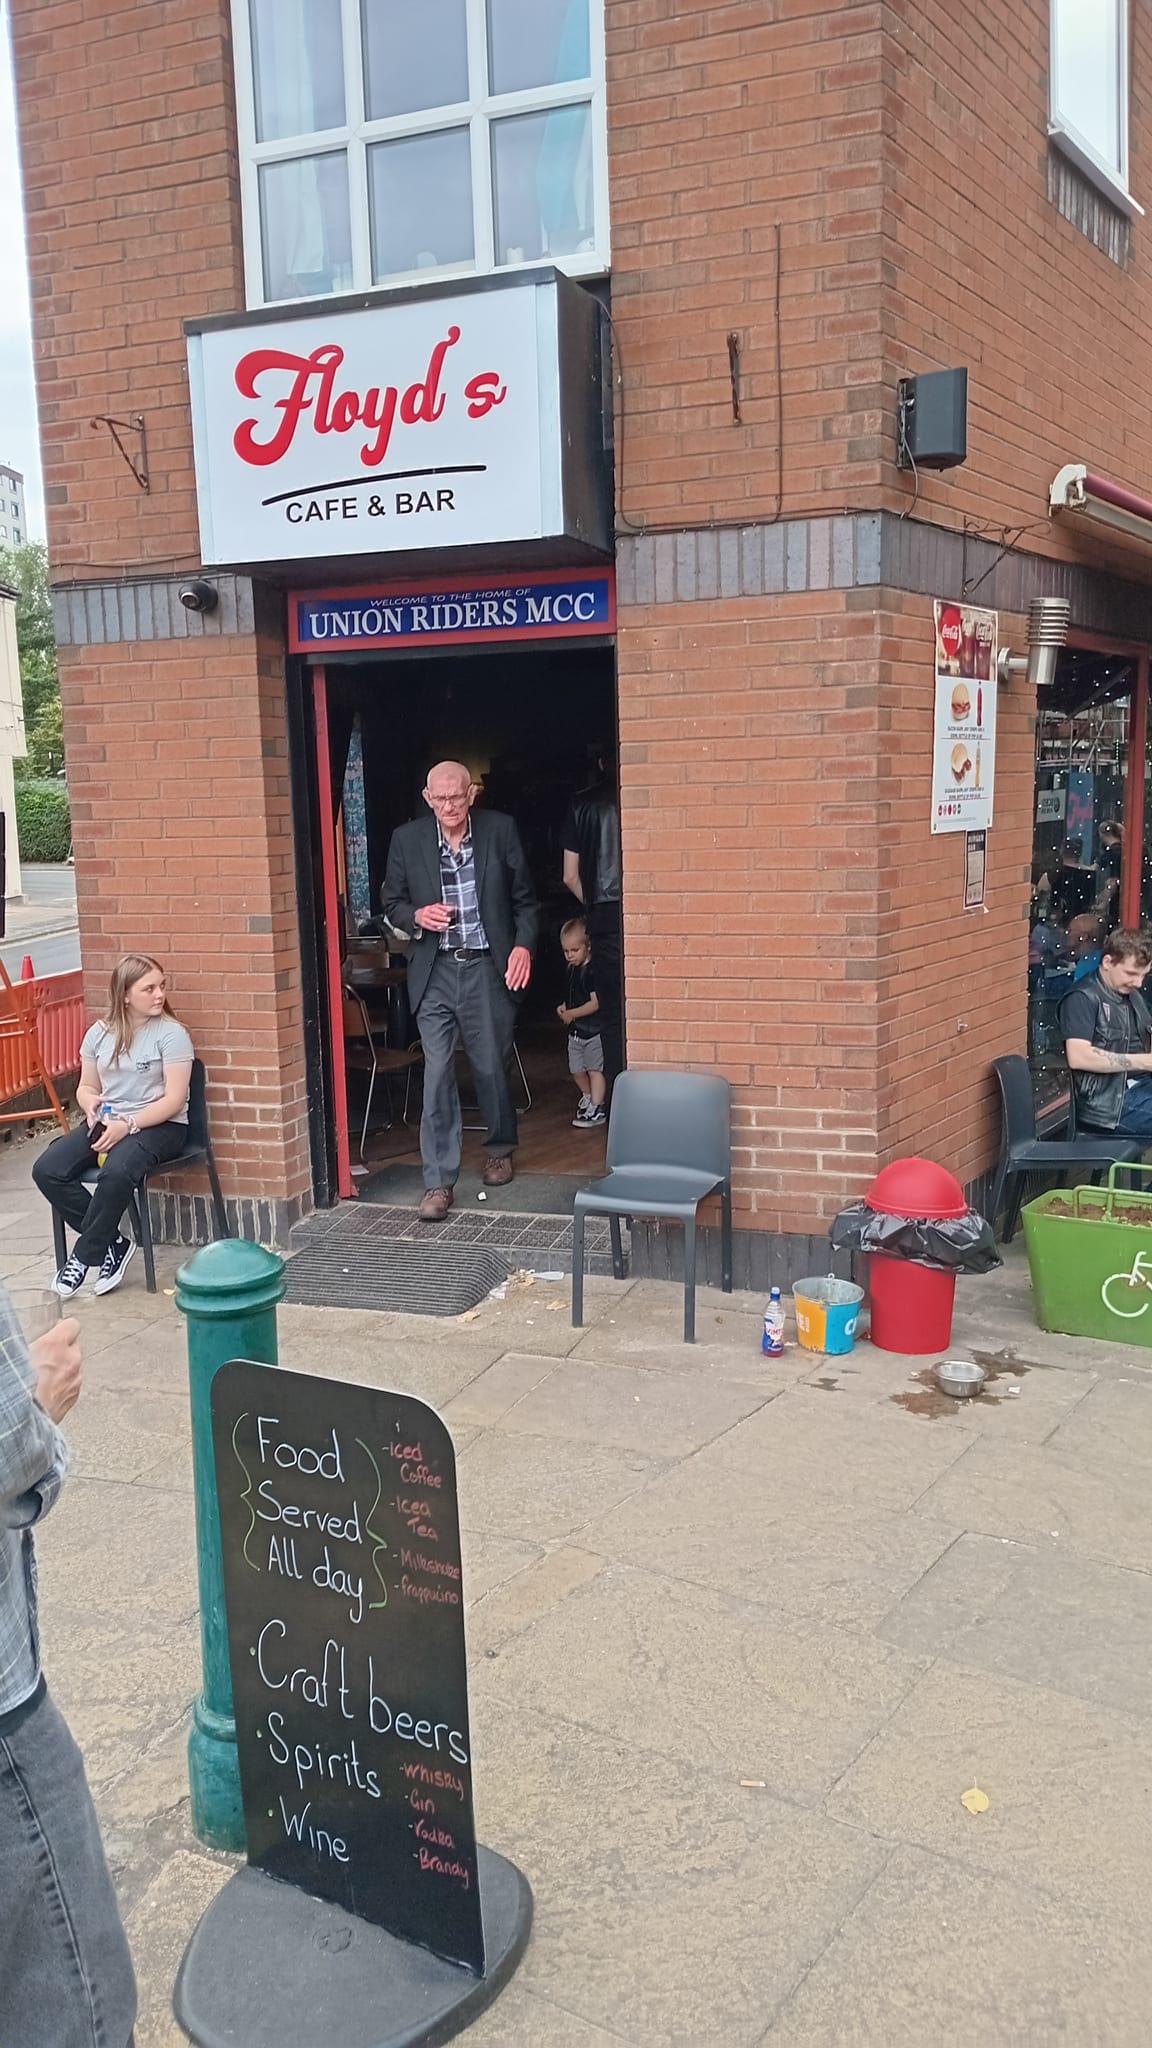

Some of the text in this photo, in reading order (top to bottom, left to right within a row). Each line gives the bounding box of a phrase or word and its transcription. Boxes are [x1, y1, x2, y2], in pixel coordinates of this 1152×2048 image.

[285, 489, 456, 524] CAFE & BAR
[308, 592, 596, 640] UNION RIDERS MCC
[370, 587, 532, 607] WELCOME TO THE HOME OF
[257, 1416, 345, 1483] Food
[400, 1462, 442, 1489] Coffee
[256, 1480, 363, 1545] Served
[407, 1516, 439, 1542] Tea
[268, 1534, 363, 1624] All day
[257, 1619, 468, 1765] Craft beers
[267, 1711, 381, 1798] Spirits
[279, 1795, 350, 1862] Wine
[410, 1788, 435, 1814] Gin
